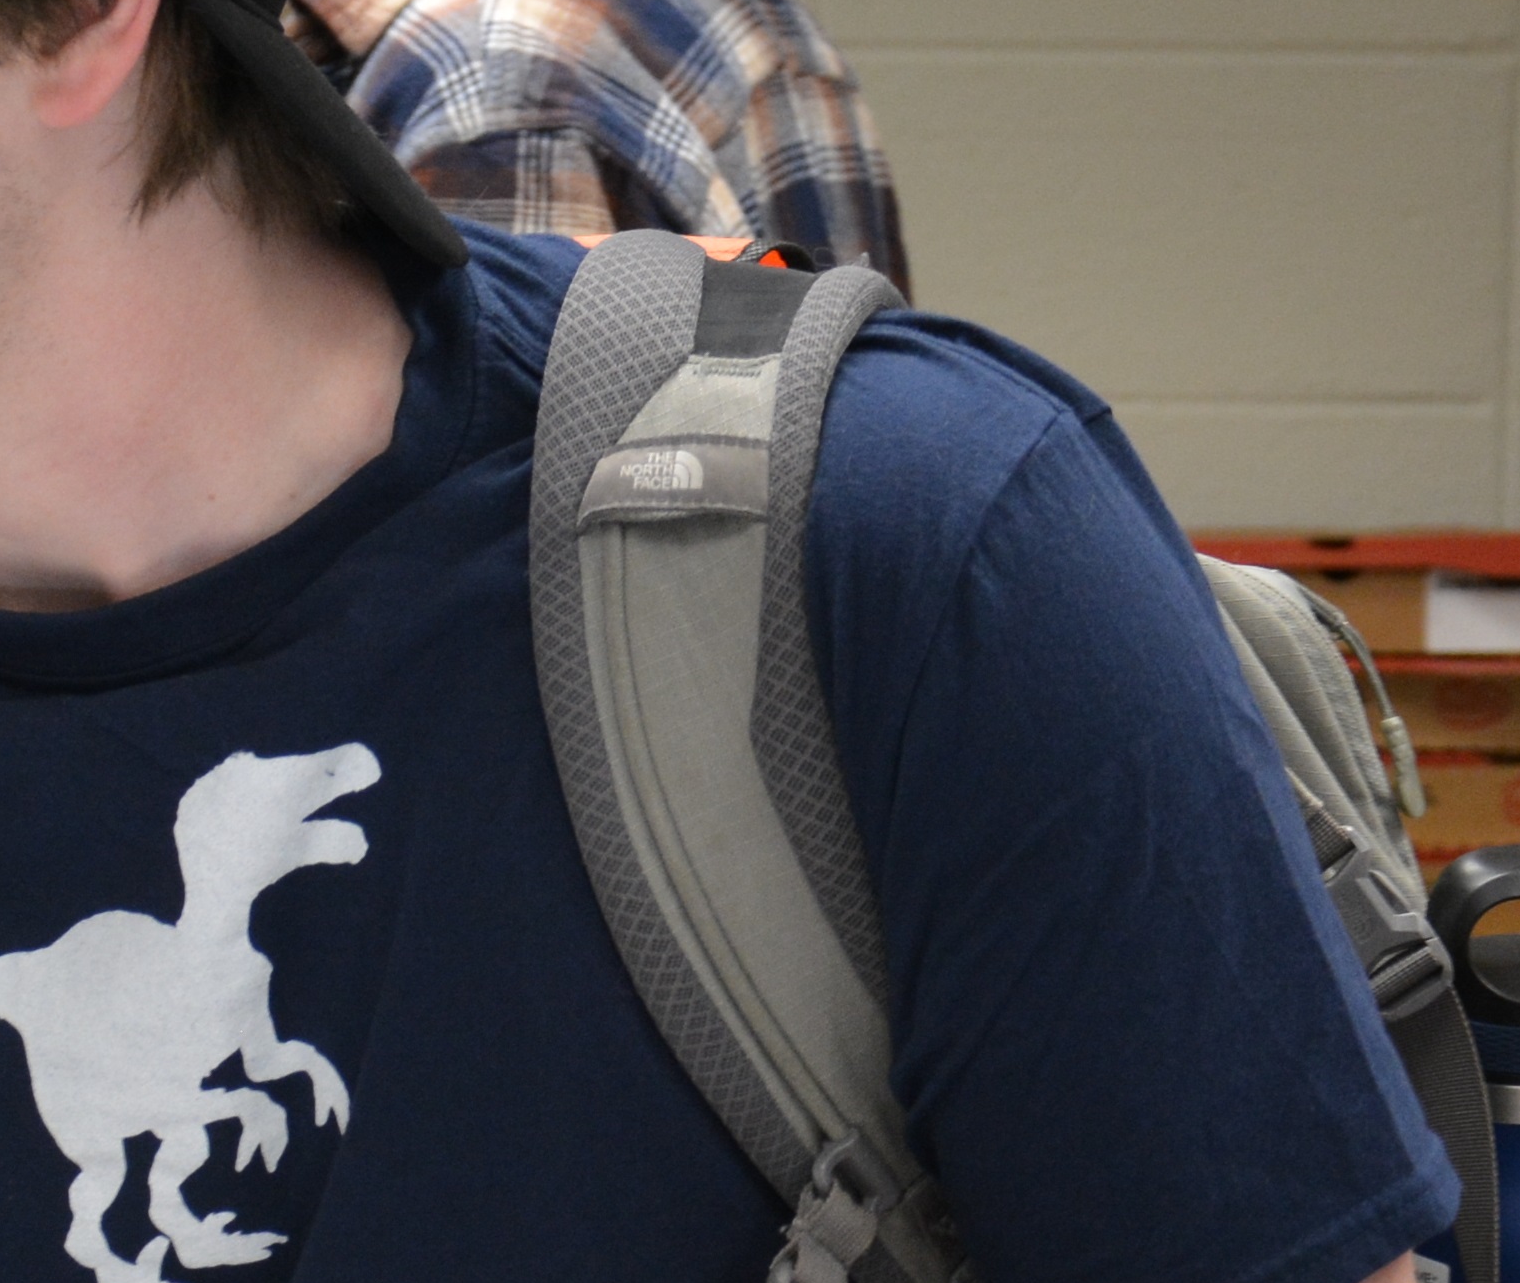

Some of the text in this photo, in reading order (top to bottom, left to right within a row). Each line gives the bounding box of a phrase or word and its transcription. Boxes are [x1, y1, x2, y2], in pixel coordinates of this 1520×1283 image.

[646, 451, 674, 464] THE
[619, 463, 674, 478] NORTH
[632, 477, 673, 491] FACE
